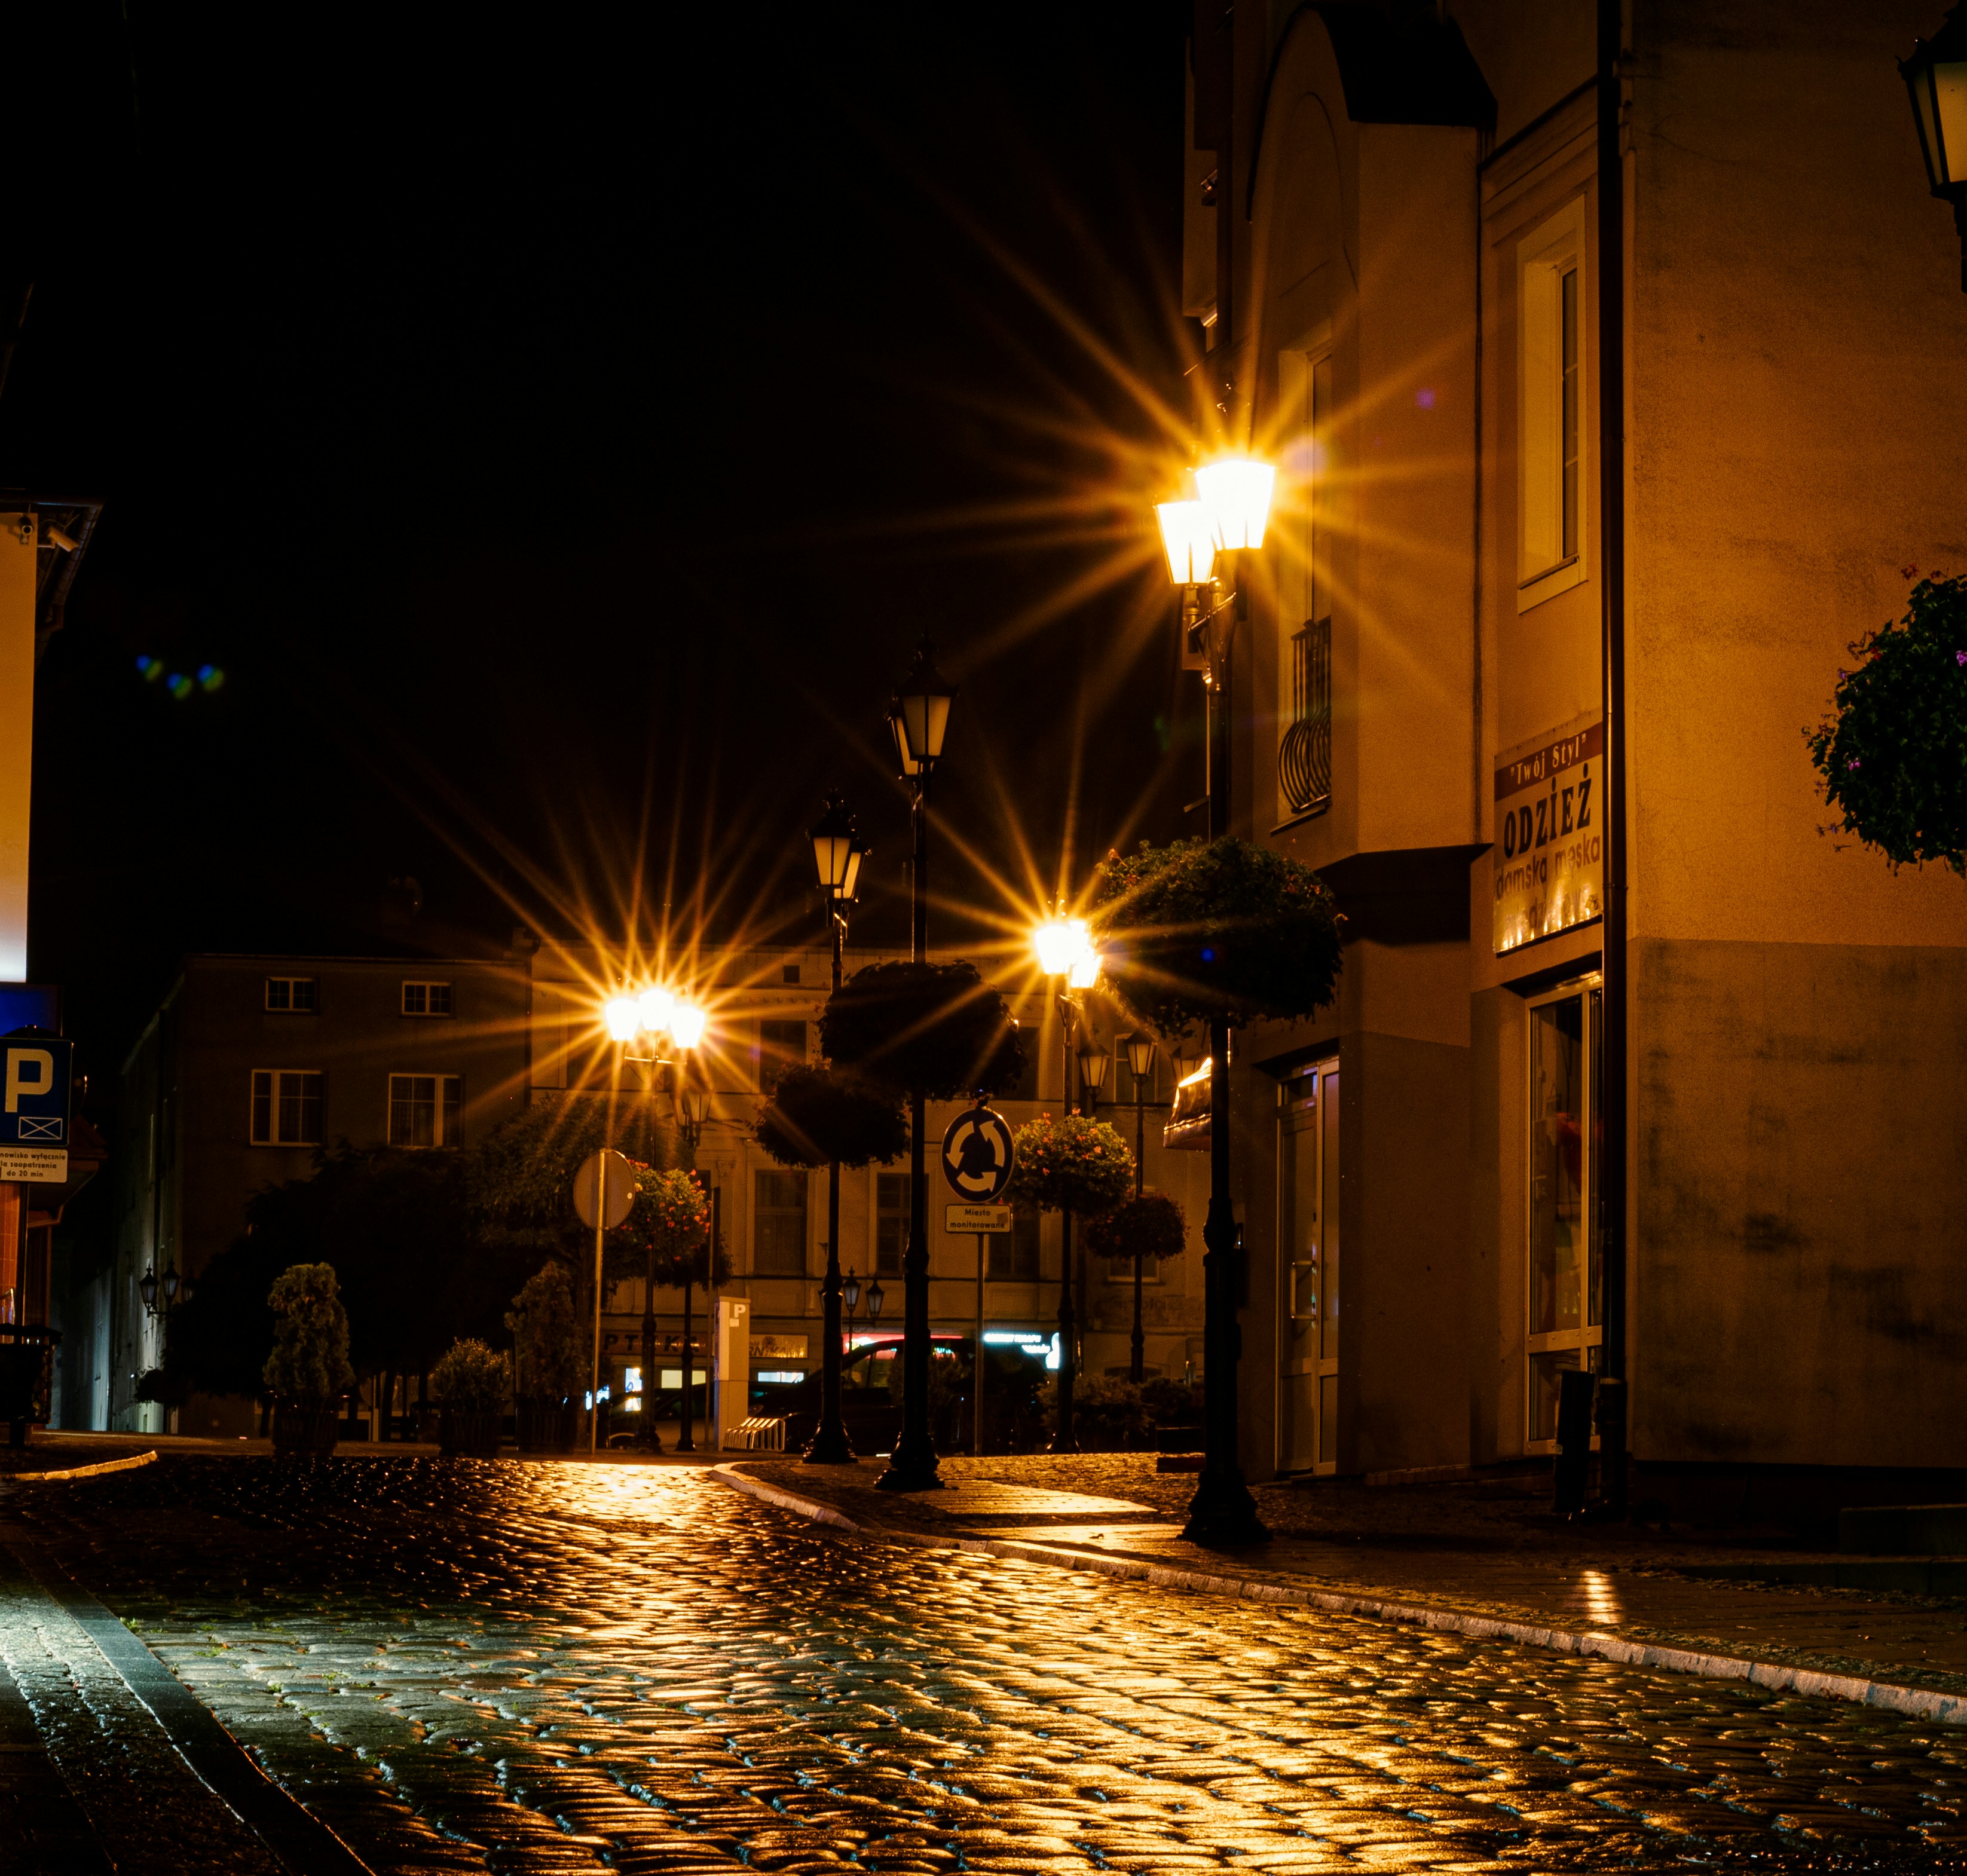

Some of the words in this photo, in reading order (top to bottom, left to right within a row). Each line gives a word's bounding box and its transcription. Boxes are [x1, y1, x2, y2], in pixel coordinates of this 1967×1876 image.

[1495, 855, 1548, 900] damska
[5, 1048, 54, 1113] P
[964, 1208, 991, 1217] Miasto
[733, 1303, 747, 1318] P
